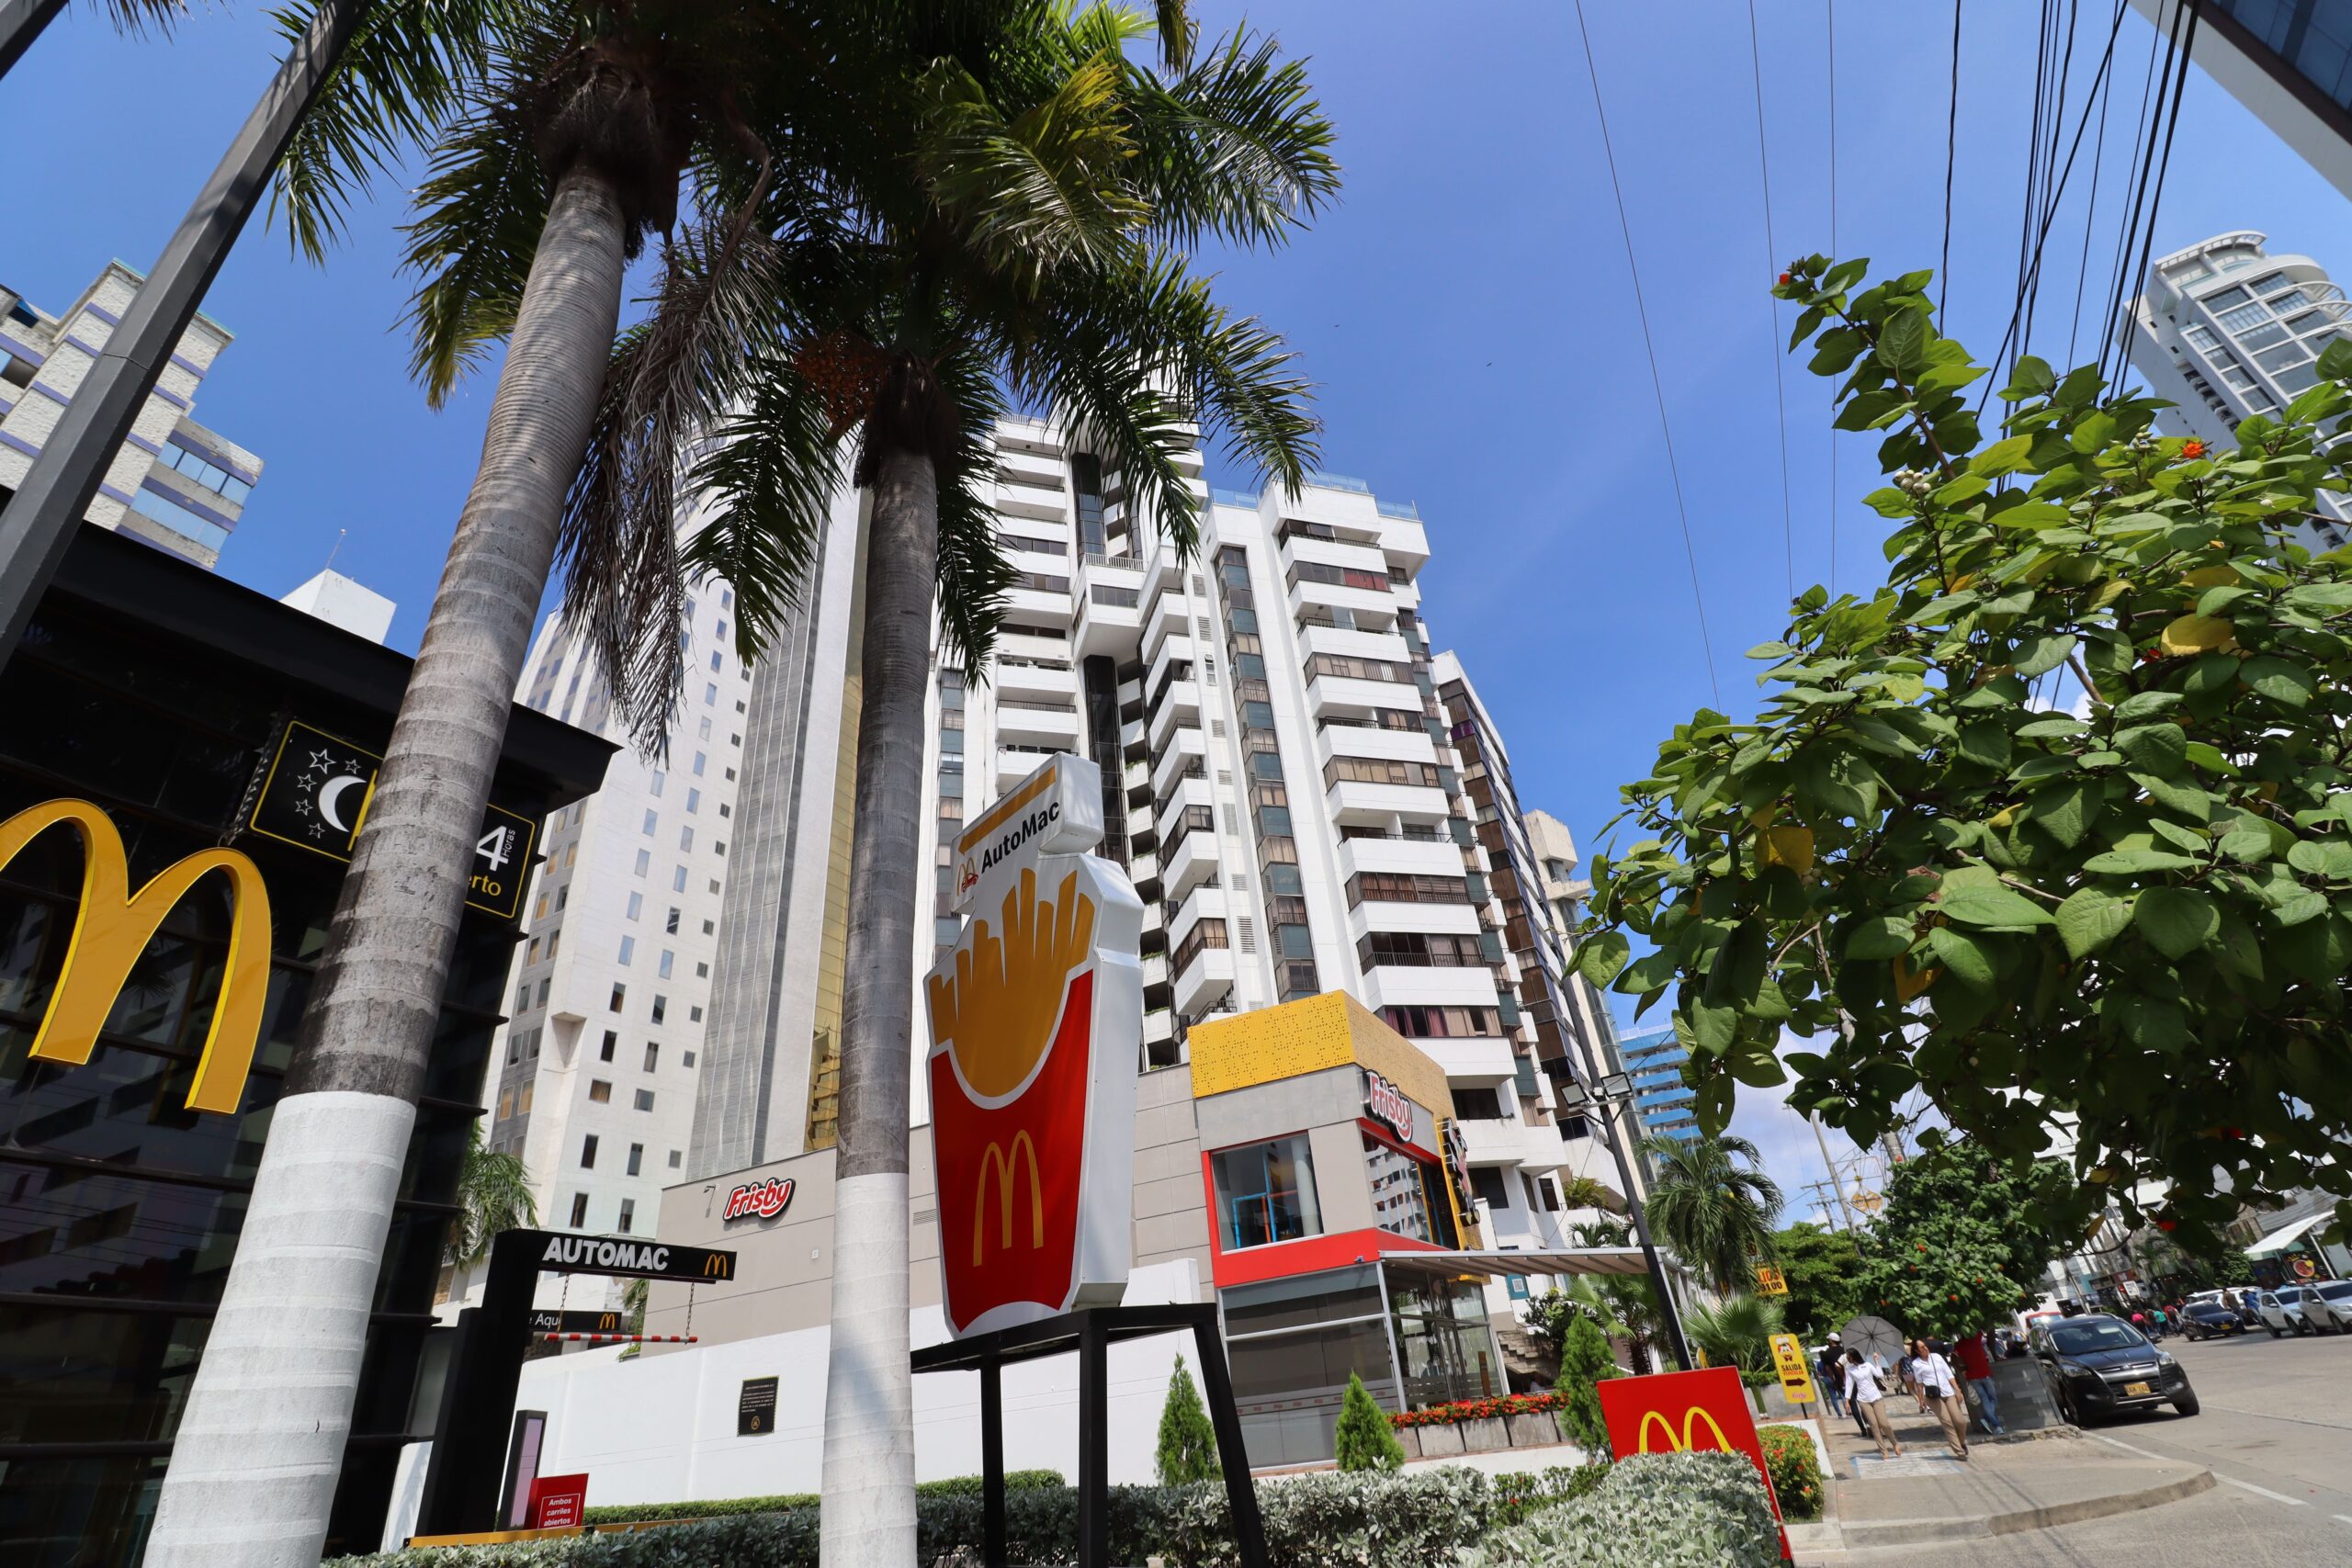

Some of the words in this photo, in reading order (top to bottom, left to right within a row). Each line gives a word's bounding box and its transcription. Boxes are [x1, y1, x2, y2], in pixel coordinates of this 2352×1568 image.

[501, 829, 516, 857] Horas
[980, 801, 1060, 874] AutoMac
[469, 874, 502, 897] rto
[1371, 1073, 1412, 1142] Frisby
[724, 1179, 792, 1219] Frisby
[542, 1236, 670, 1271] AUTOMAC
[1781, 1363, 1803, 1371] SALIDA
[546, 1507, 571, 1517] carriles
[548, 1497, 572, 1506] Ambos
[543, 1517, 571, 1527] abiertos
